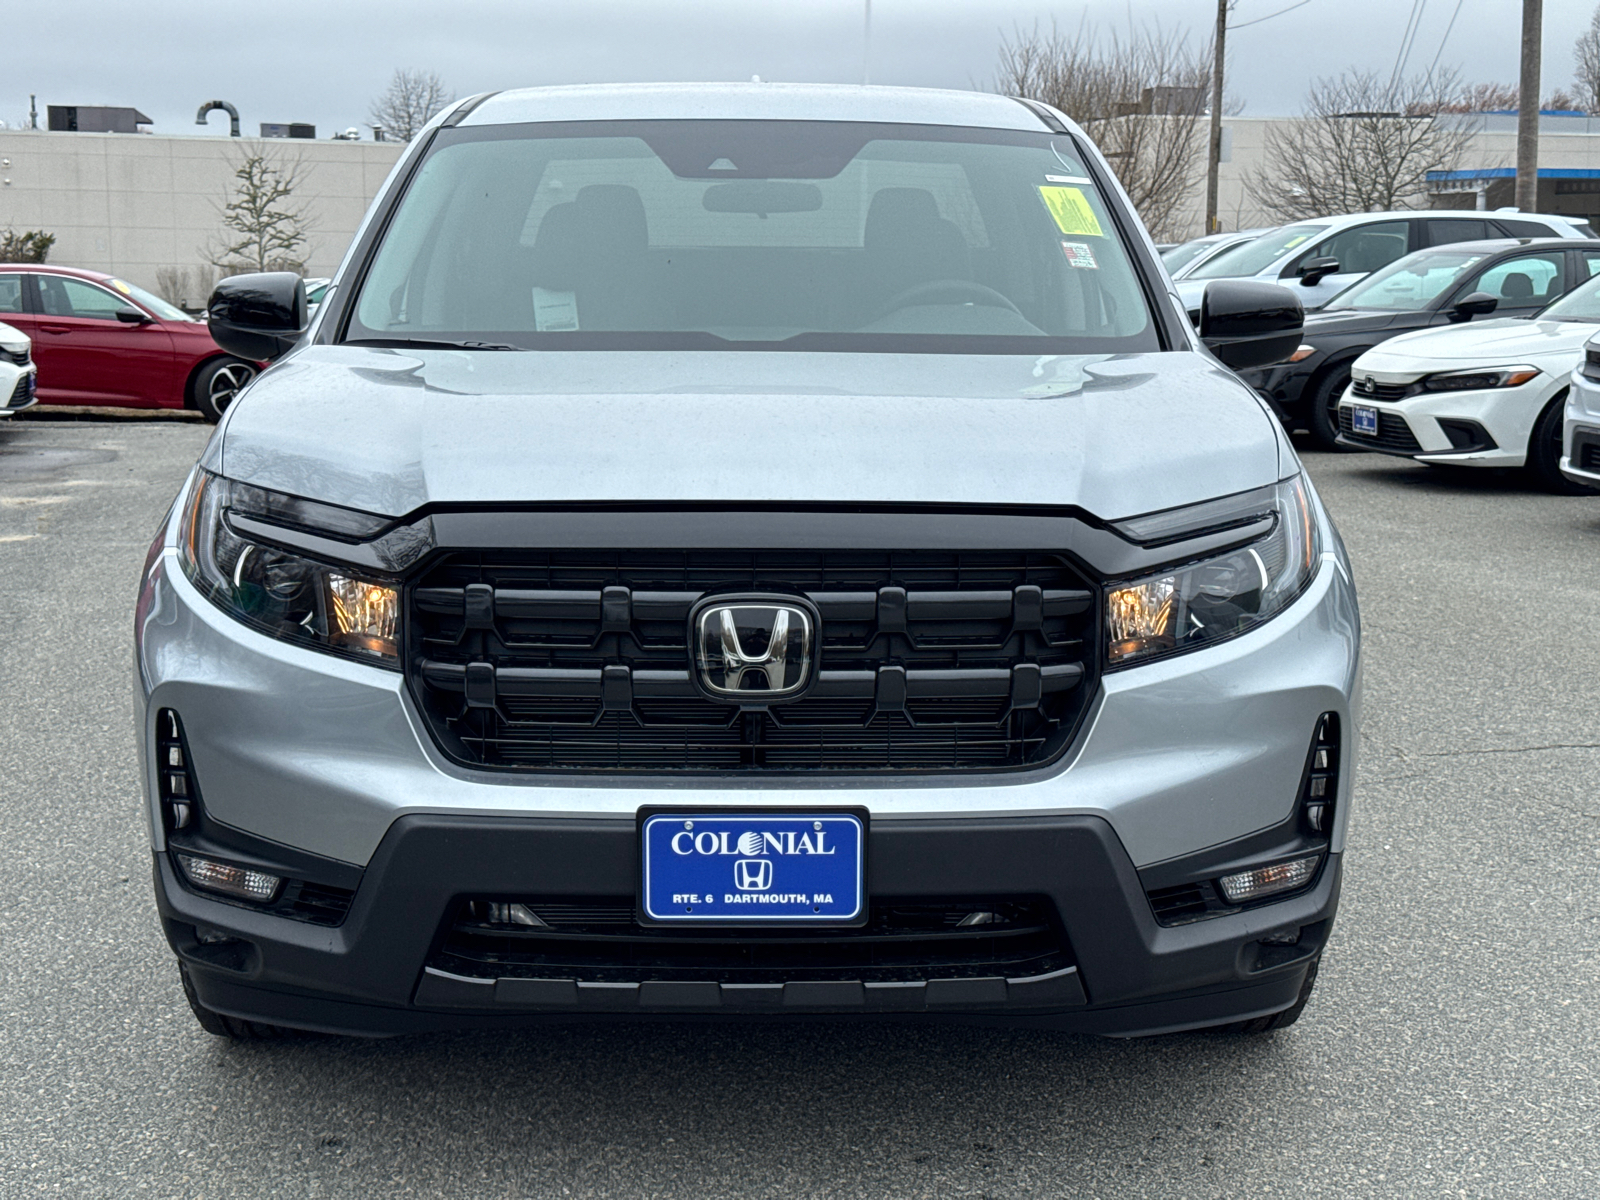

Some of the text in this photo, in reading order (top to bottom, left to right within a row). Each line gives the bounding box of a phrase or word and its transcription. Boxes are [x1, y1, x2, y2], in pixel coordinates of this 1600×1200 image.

[671, 831, 835, 856] COLONIAL
[673, 894, 834, 905] RTE. 6 DARTMOUTH, MA
